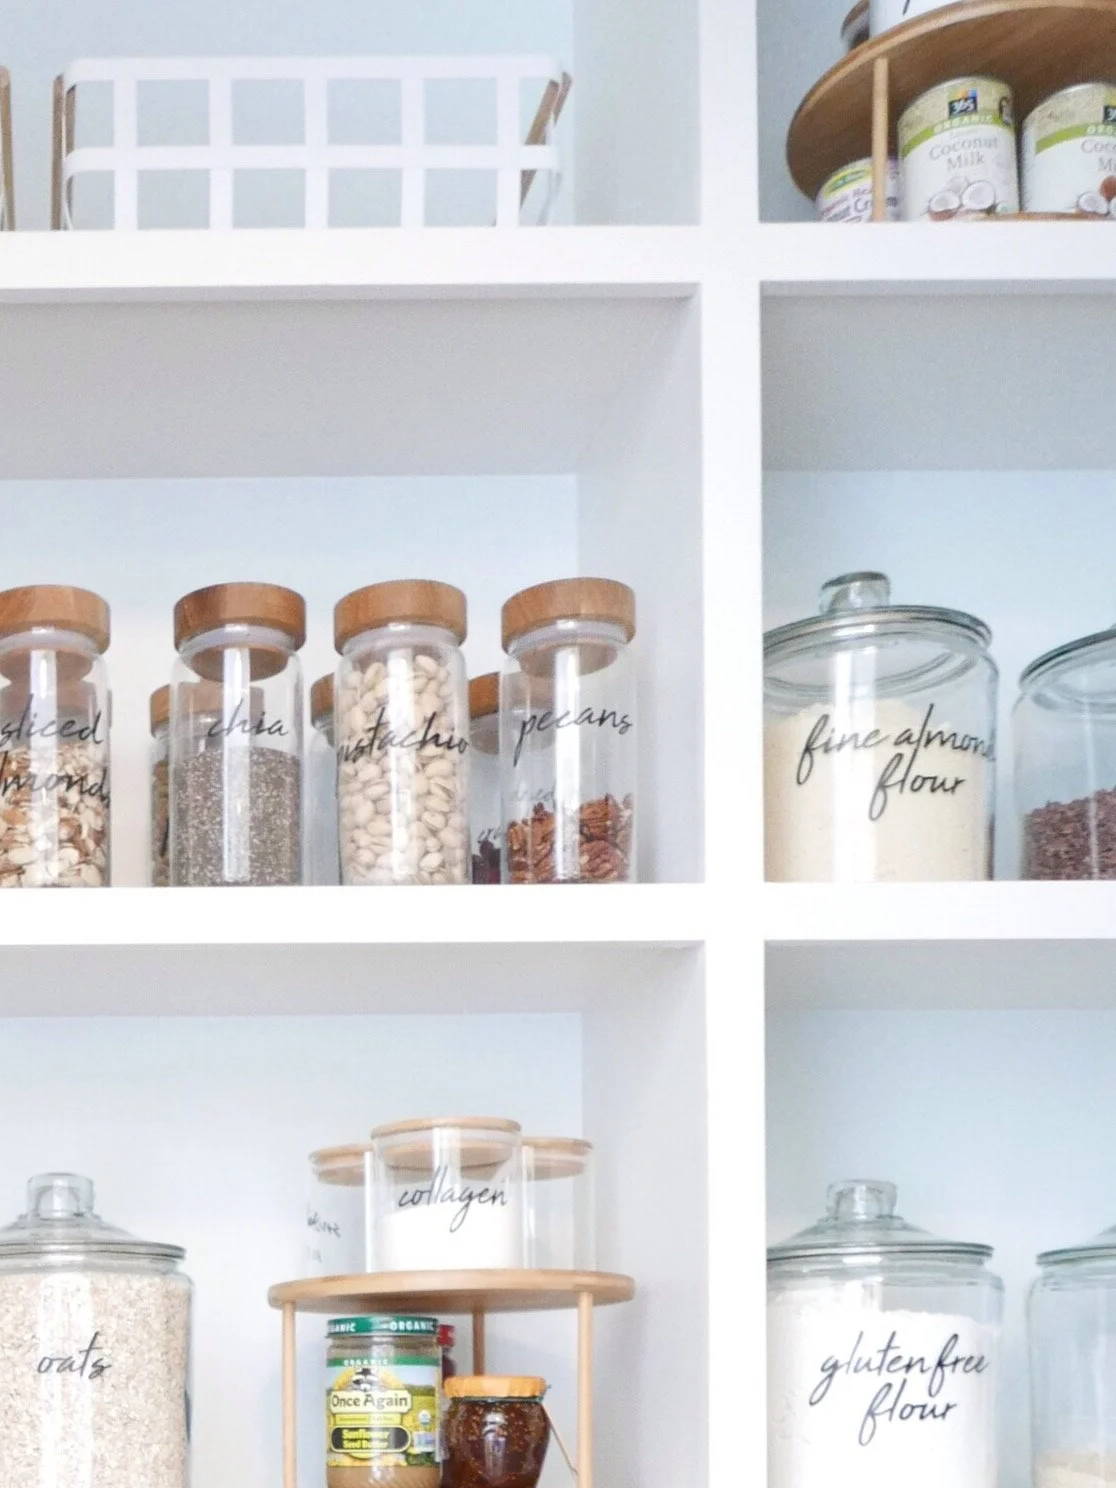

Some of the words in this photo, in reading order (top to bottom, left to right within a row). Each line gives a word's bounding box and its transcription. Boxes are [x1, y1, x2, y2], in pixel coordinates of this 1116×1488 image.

[928, 136, 999, 161] Coconut
[946, 151, 985, 173] Milk
[207, 698, 290, 739] chia
[339, 706, 470, 765] istachio
[513, 707, 633, 768] pecans
[795, 713, 889, 786] fine
[868, 751, 967, 822] flour
[397, 1165, 510, 1234] collagen
[388, 1321, 436, 1332] ORGANIC
[36, 1330, 113, 1381] oats
[331, 1394, 361, 1408] Once
[363, 1393, 409, 1411] Again
[858, 1378, 959, 1447] flour
